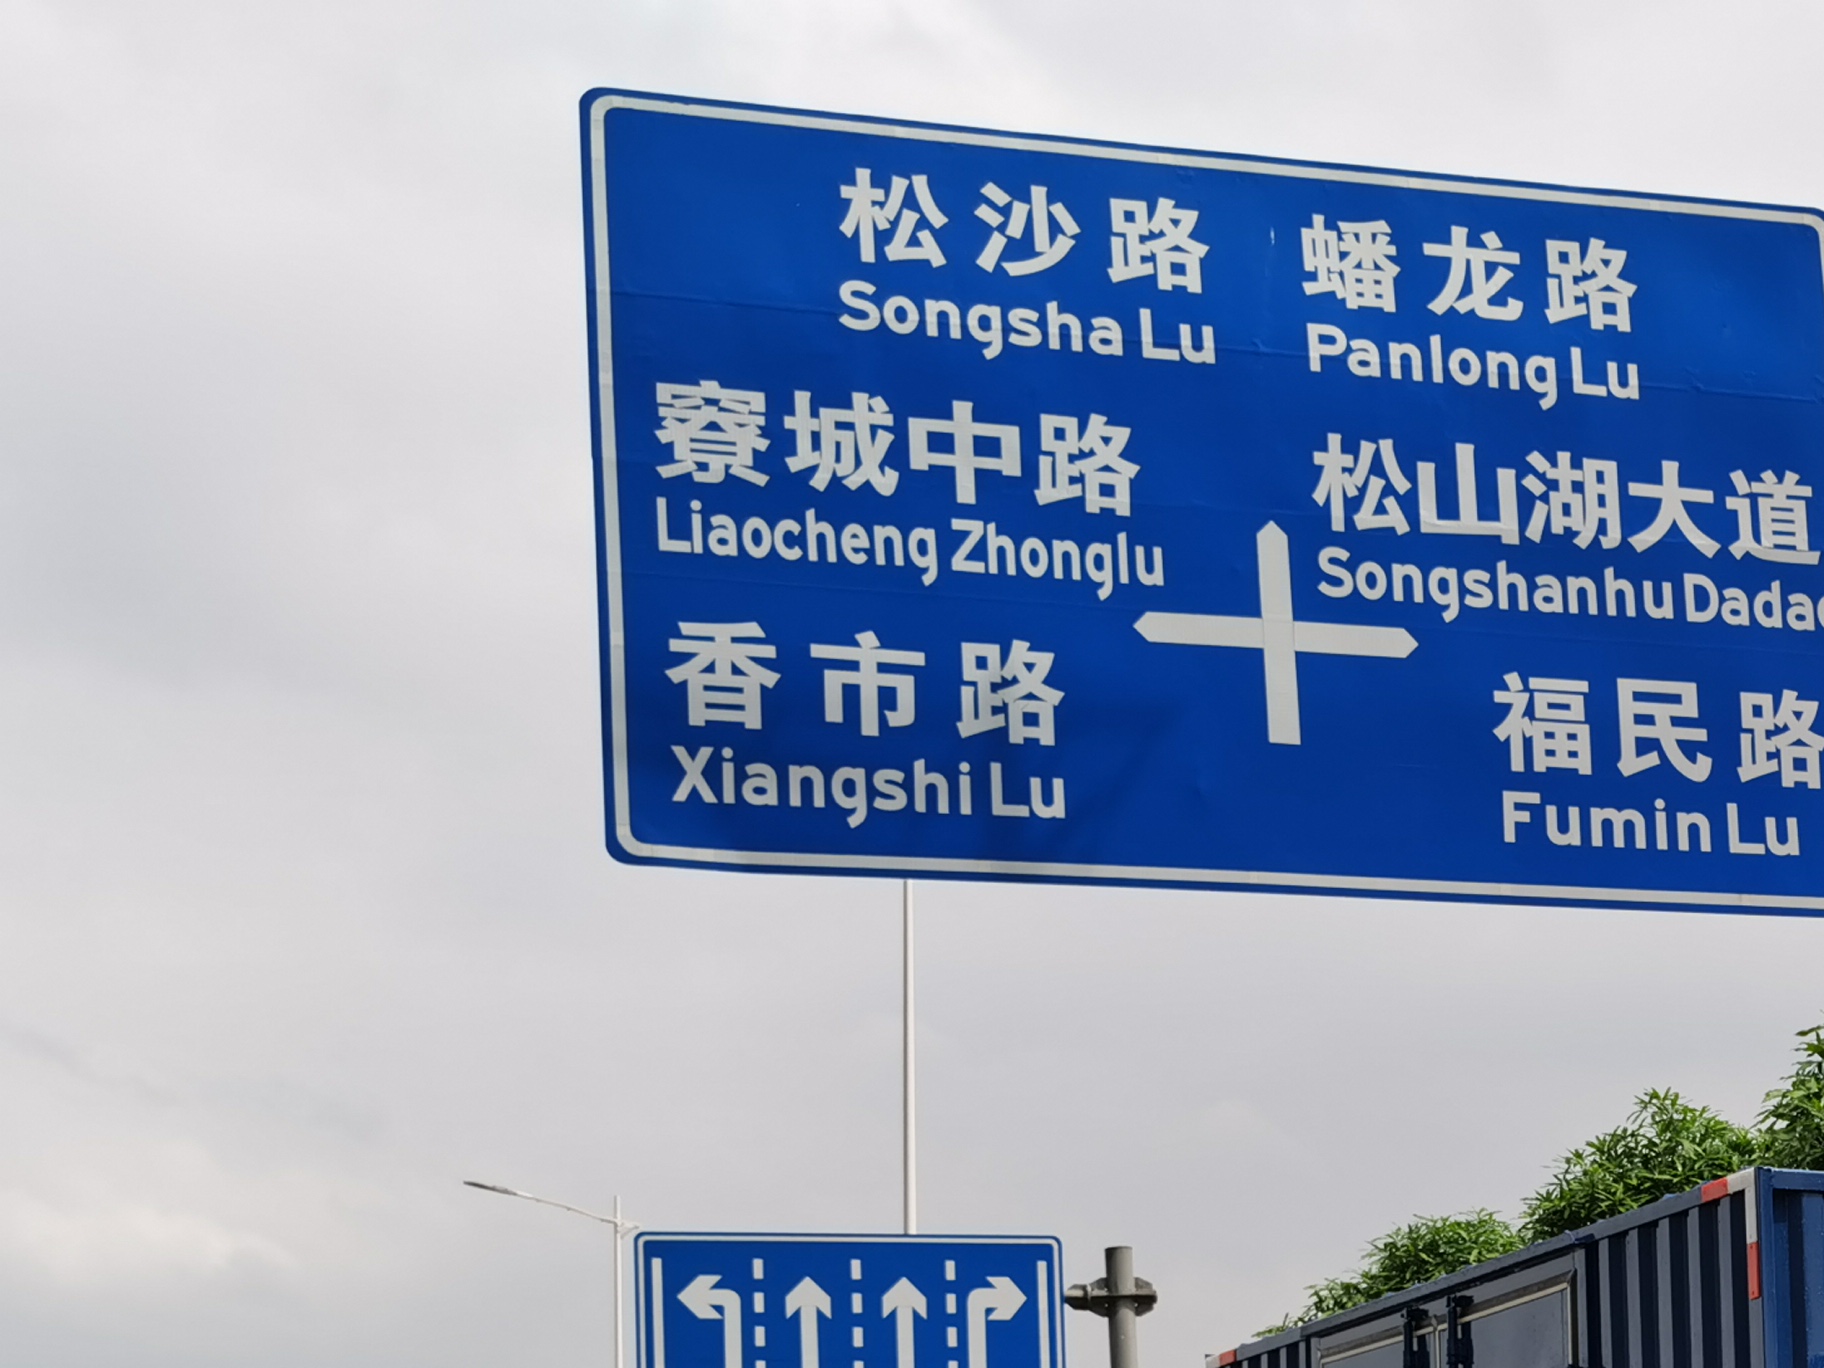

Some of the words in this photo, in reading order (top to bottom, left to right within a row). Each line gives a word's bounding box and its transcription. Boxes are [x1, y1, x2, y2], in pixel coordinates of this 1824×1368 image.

[839, 167, 1210, 294] 松沙路
[1300, 214, 1638, 333] 蟠龙路
[839, 279, 1124, 360] Songsha
[1139, 308, 1216, 365] Lu
[1306, 322, 1558, 411] Panlong
[1570, 346, 1640, 401] Lu
[1312, 432, 1821, 566] 松山湖大道
[656, 496, 939, 587] Liaocheng
[951, 518, 1165, 601] Zhonglu
[1317, 546, 1675, 623] Songshanhu
[665, 621, 1065, 746] 香市路
[671, 745, 972, 829] Xiangshi
[990, 762, 1066, 819] Lu
[1502, 790, 1712, 853] Fumin
[1726, 802, 1801, 857] Lu
